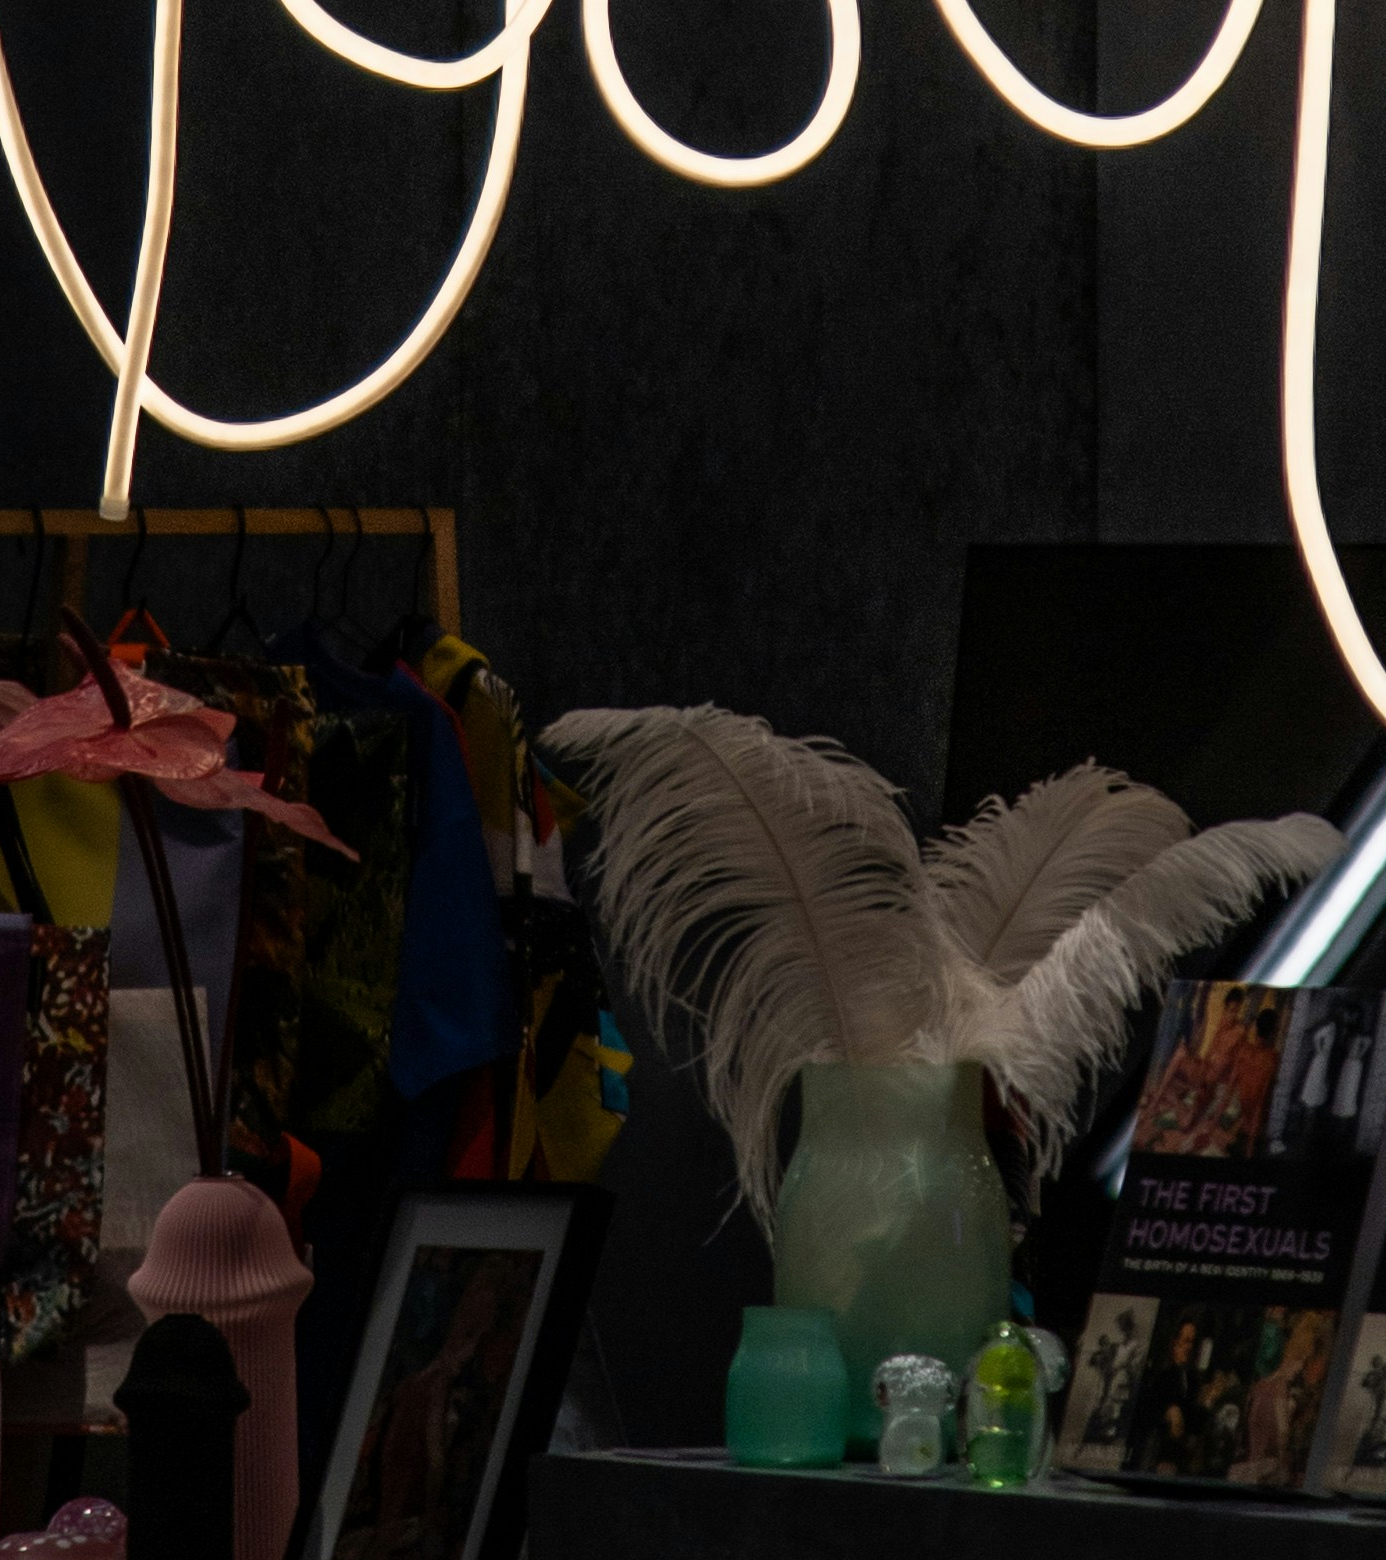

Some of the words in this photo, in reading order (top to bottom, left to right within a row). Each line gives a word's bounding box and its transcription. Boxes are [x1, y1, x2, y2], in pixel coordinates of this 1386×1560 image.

[1139, 1179, 1192, 1211] THE
[1198, 1182, 1278, 1216] FIRST
[1126, 1217, 1333, 1261] HOMOSEXUALS
[1123, 1256, 1142, 1270] THE
[1143, 1258, 1174, 1273] BIRTH
[1175, 1261, 1188, 1275] OF
[1189, 1263, 1199, 1274] A
[1200, 1263, 1223, 1276] NEW
[1225, 1265, 1269, 1279] IDENTITY
